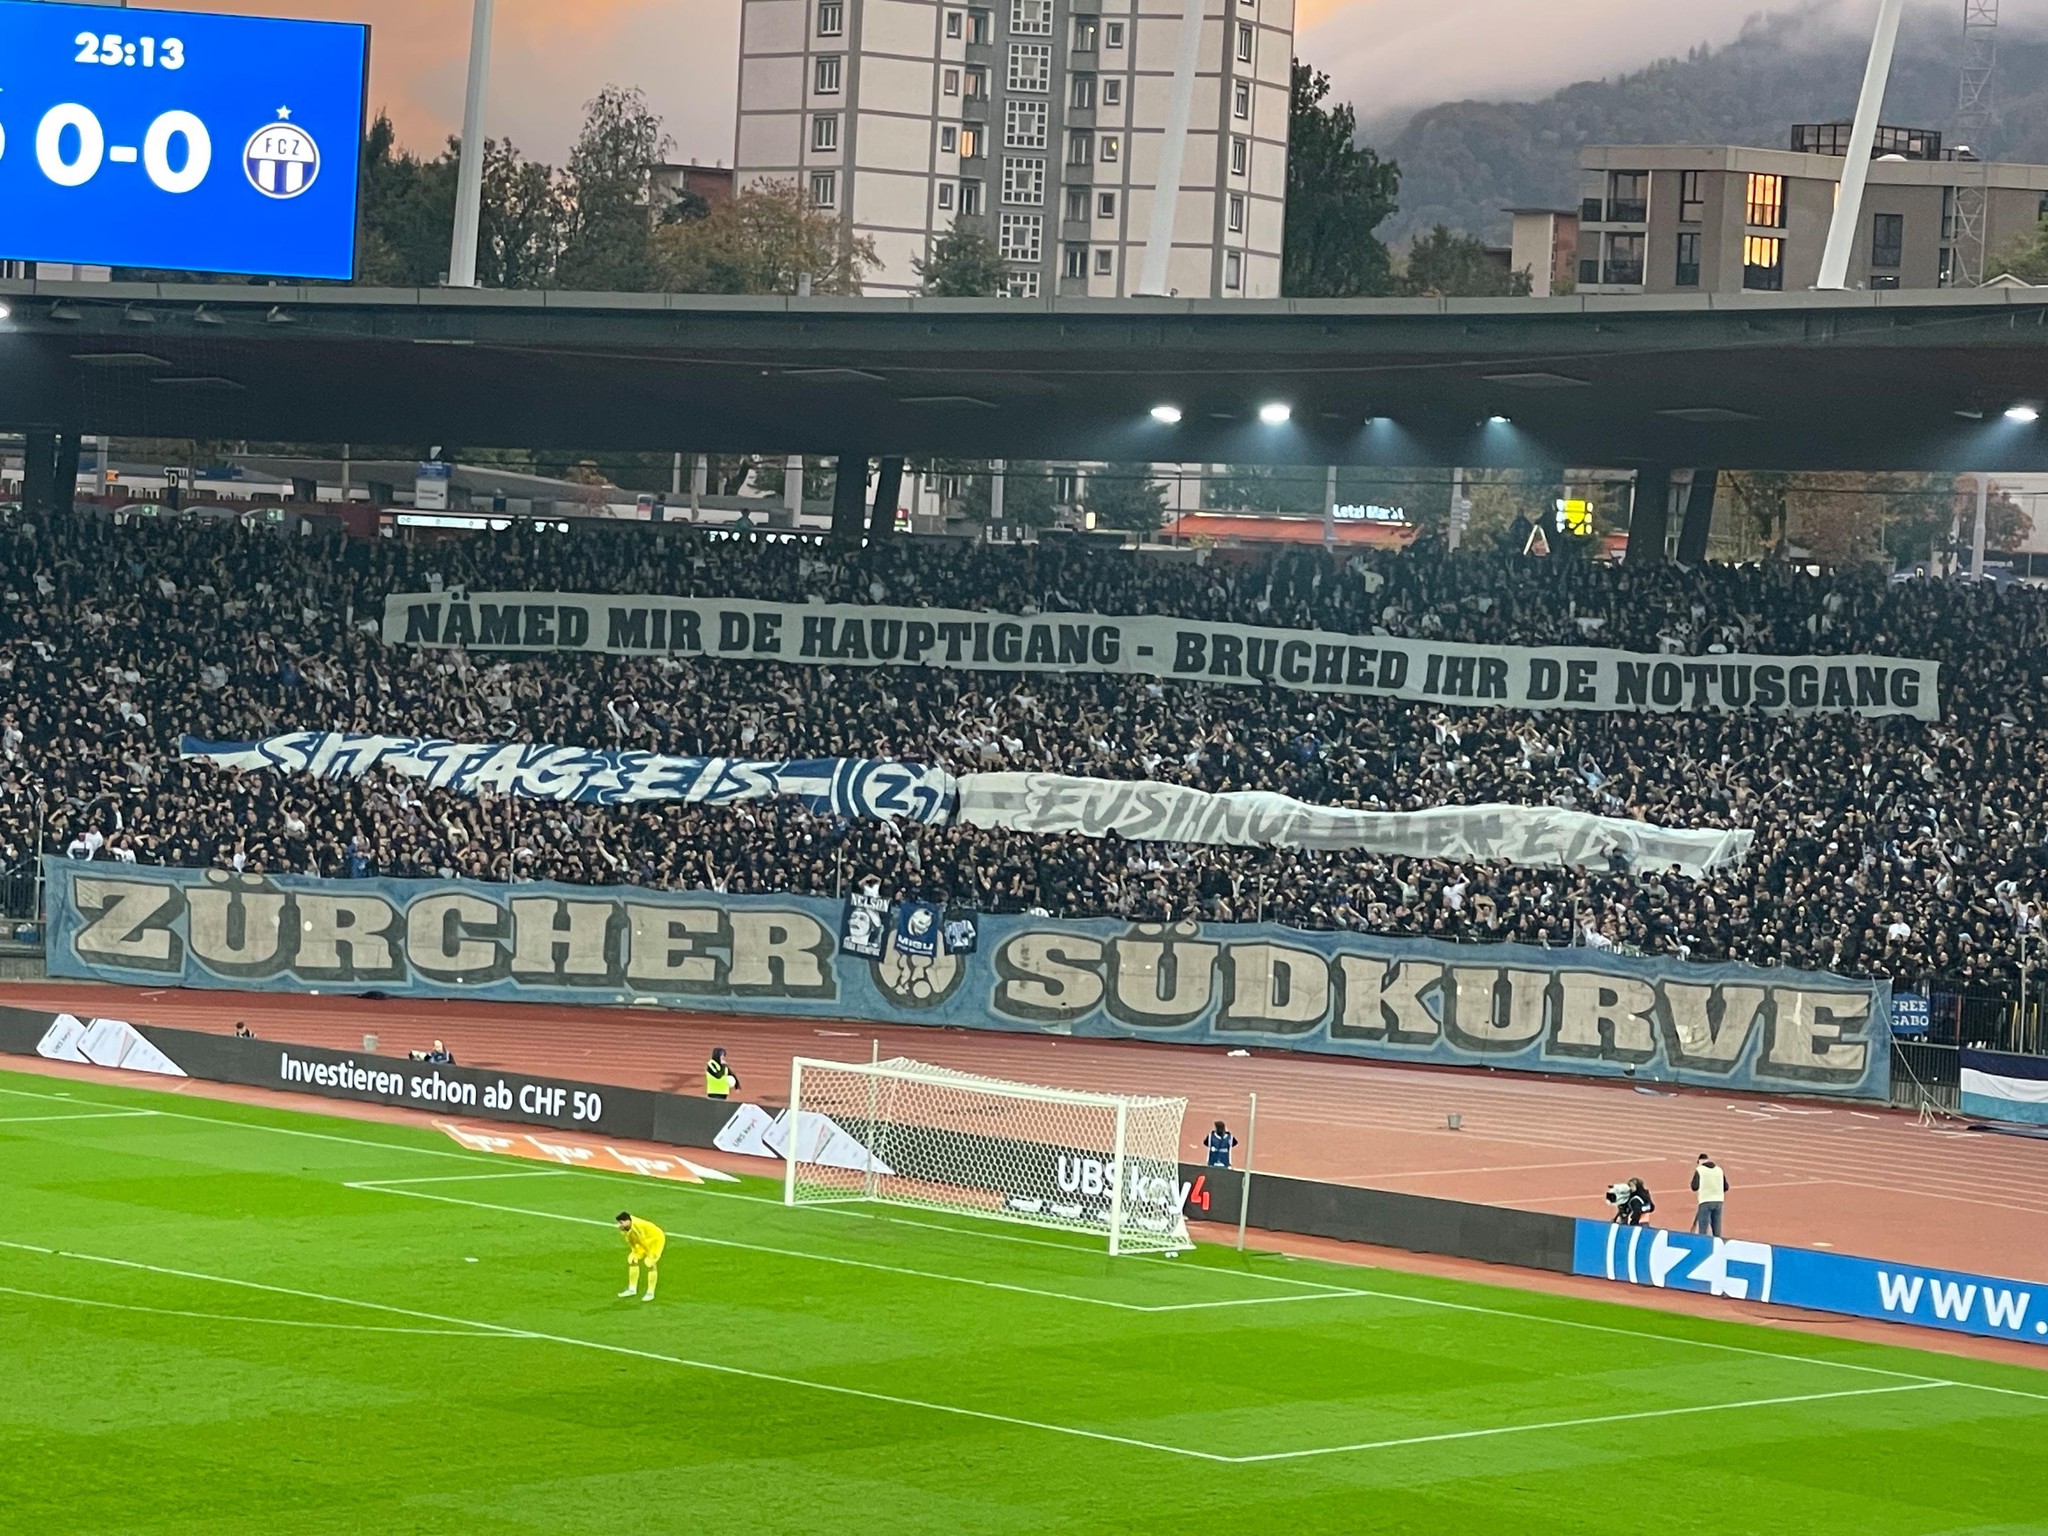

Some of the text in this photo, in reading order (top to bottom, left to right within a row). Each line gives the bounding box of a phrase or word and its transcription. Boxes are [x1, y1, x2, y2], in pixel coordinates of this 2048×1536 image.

[74, 31, 185, 70] 25:13
[35, 102, 212, 194] 0-0
[265, 137, 300, 156] FCZ
[404, 591, 589, 646] NÄMED
[606, 607, 701, 650] MIR
[718, 610, 783, 653] DE
[799, 615, 1121, 665] HAUPTIGANG
[1172, 631, 1410, 689] BRUCHED
[1423, 653, 1508, 699] IHR
[1526, 658, 1598, 702] DE
[1615, 660, 1921, 708] NOTUSGANG
[74, 867, 1870, 1080] ZÜRCHER SÜDKURVE
[1892, 1000, 1927, 1012] FREE
[1892, 1015, 1929, 1026] GABO
[281, 1052, 602, 1122] Investieren schon ab CHF 50
[1057, 1154, 1122, 1199] UBS
